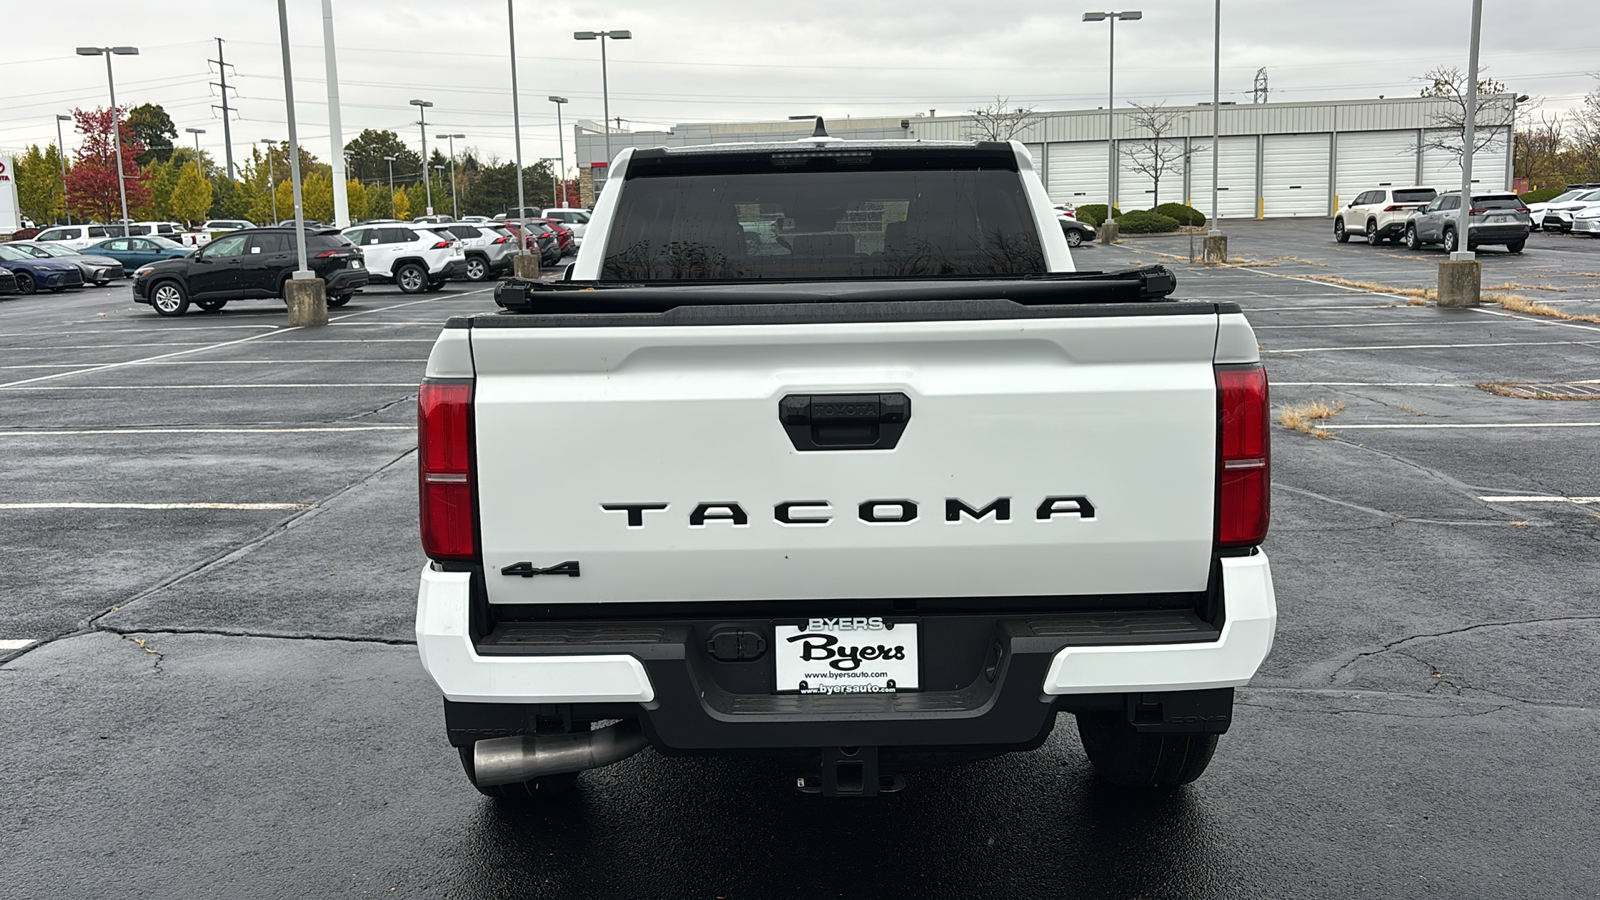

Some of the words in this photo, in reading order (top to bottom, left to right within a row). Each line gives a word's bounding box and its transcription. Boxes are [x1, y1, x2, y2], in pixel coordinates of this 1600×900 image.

[814, 404, 877, 416] TOYOTA
[600, 496, 1096, 527] TACOMA
[808, 617, 884, 631] BYERS
[786, 633, 905, 671] Byers
[804, 671, 888, 680] www.byersauto.com
[800, 682, 896, 695] www.byersauto.com
